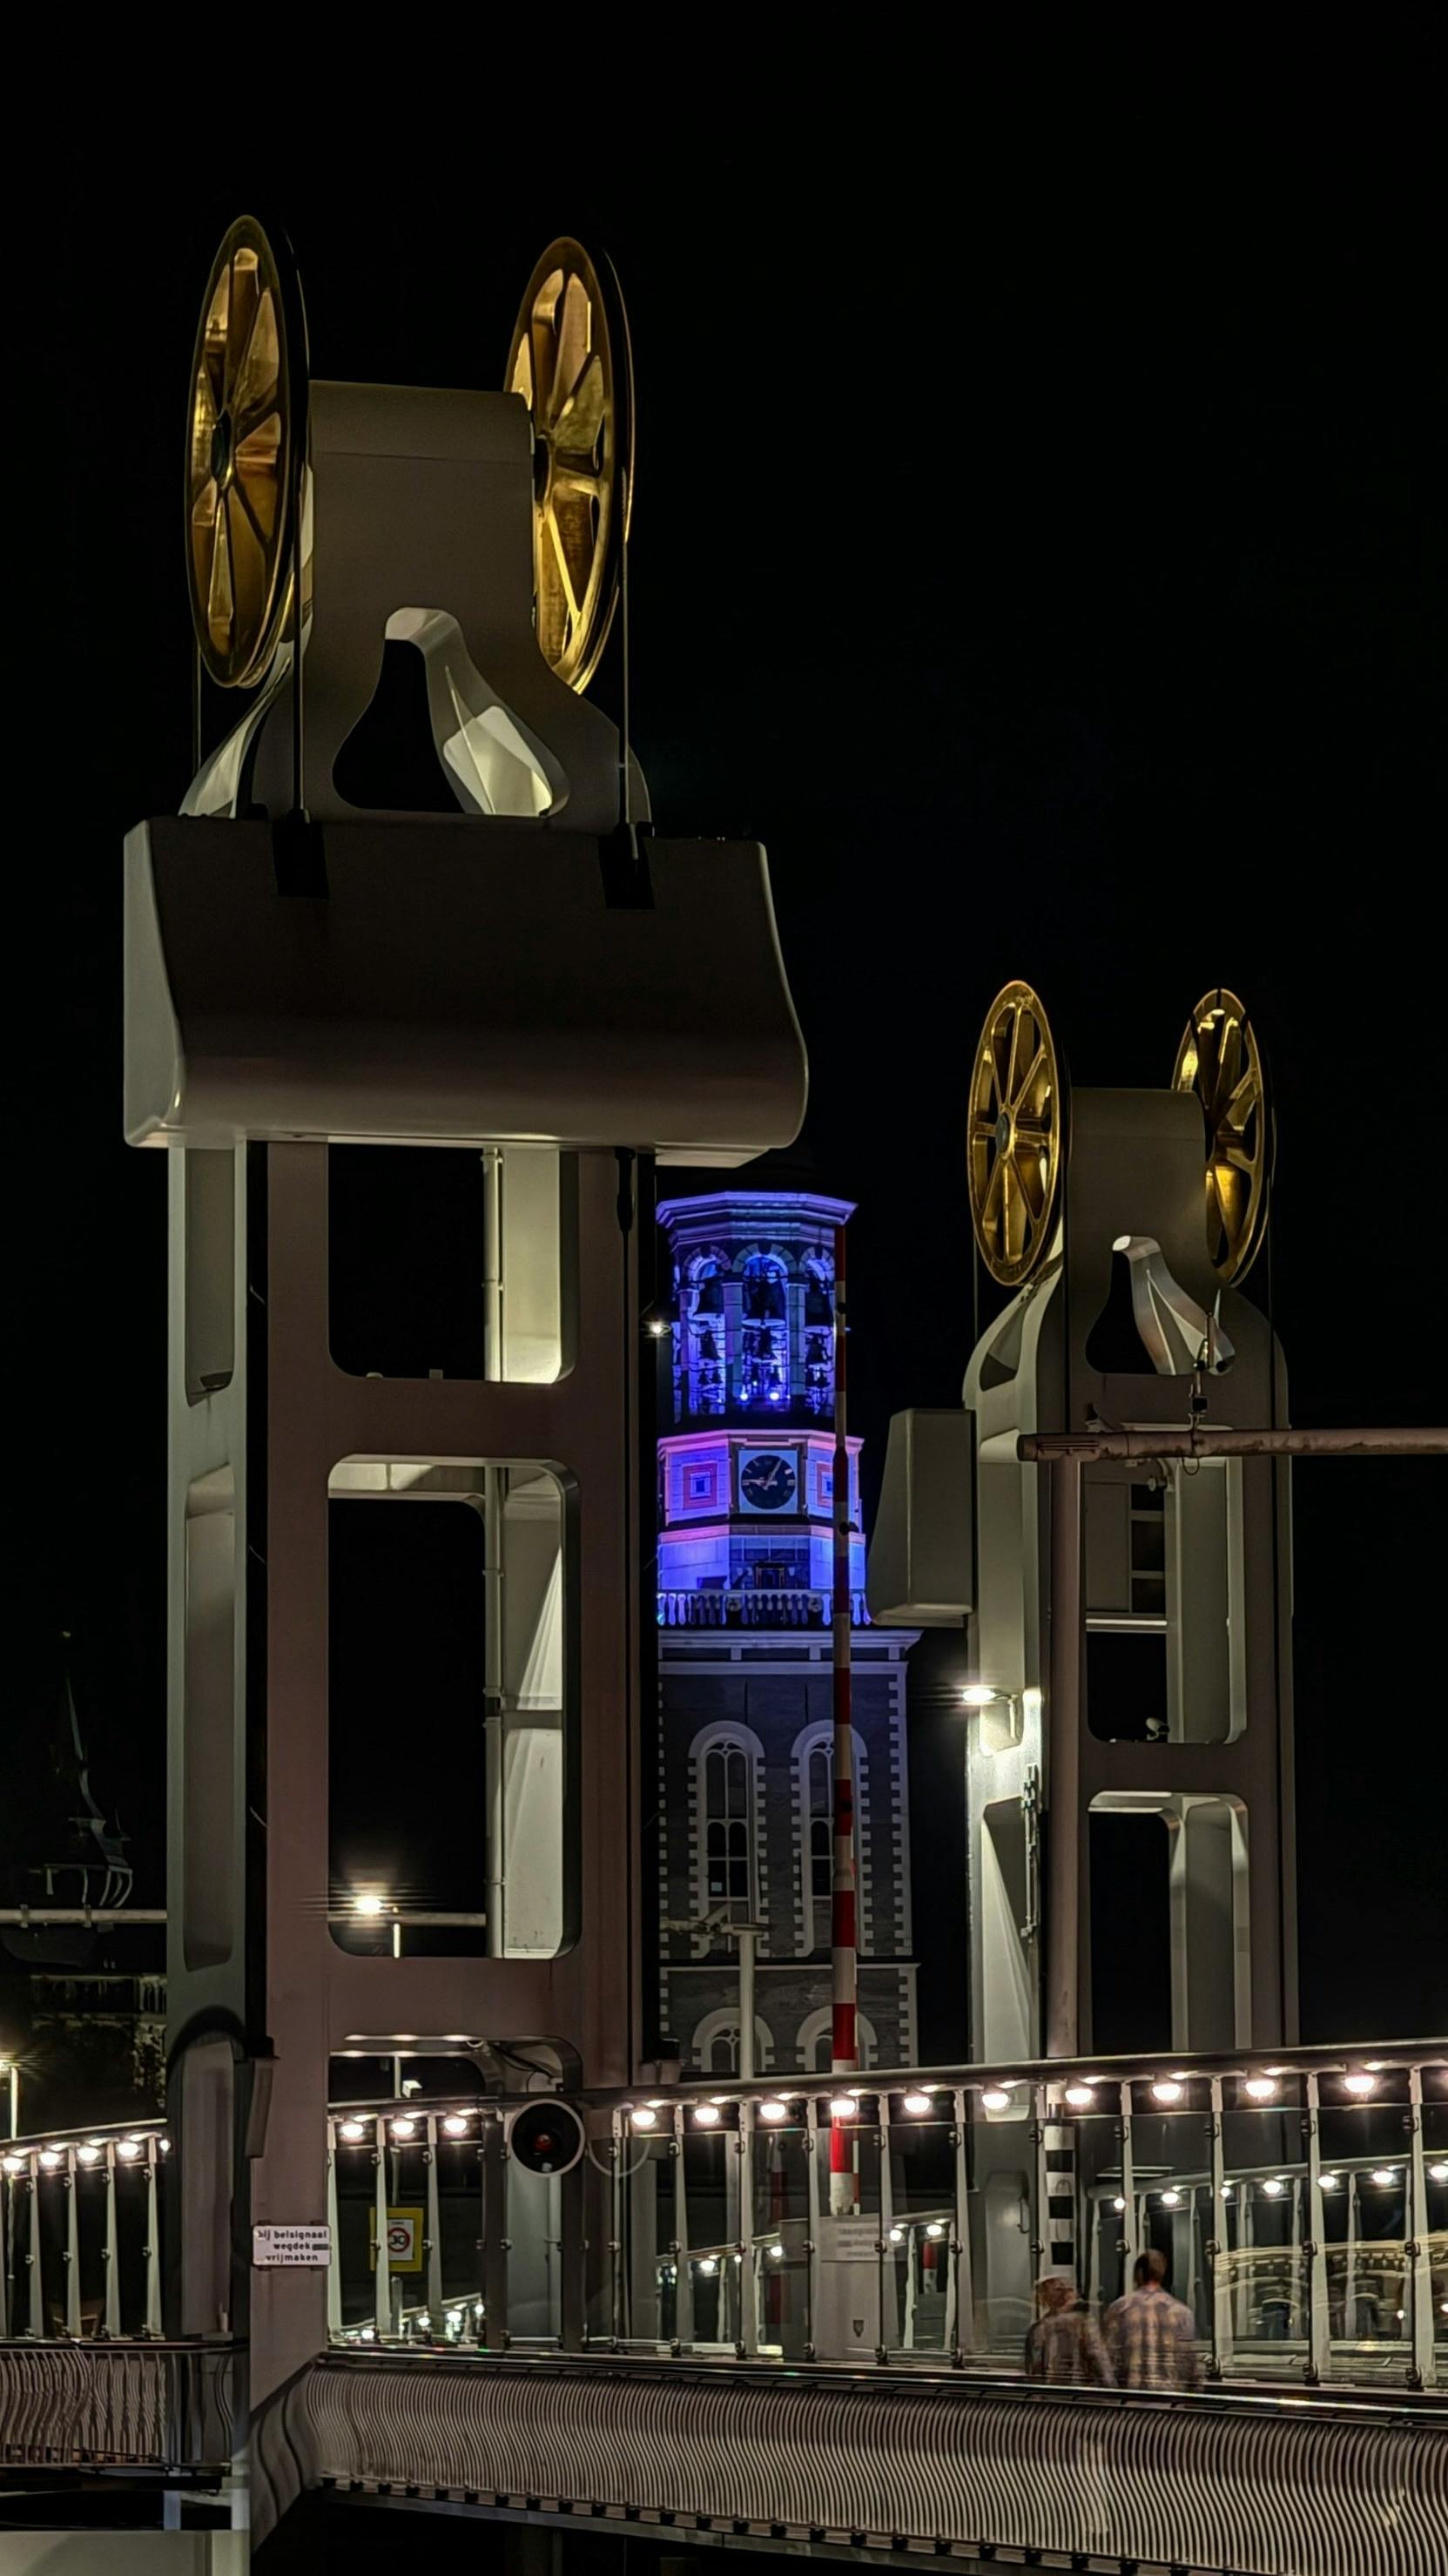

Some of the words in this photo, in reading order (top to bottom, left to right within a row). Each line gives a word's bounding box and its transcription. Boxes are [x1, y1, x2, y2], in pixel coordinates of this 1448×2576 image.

[258, 2229, 271, 2241] bij
[274, 2229, 327, 2241] belsignaal
[390, 2235, 405, 2245] 30
[273, 2242, 311, 2251] wegdek
[266, 2253, 319, 2264] vrijmaken
